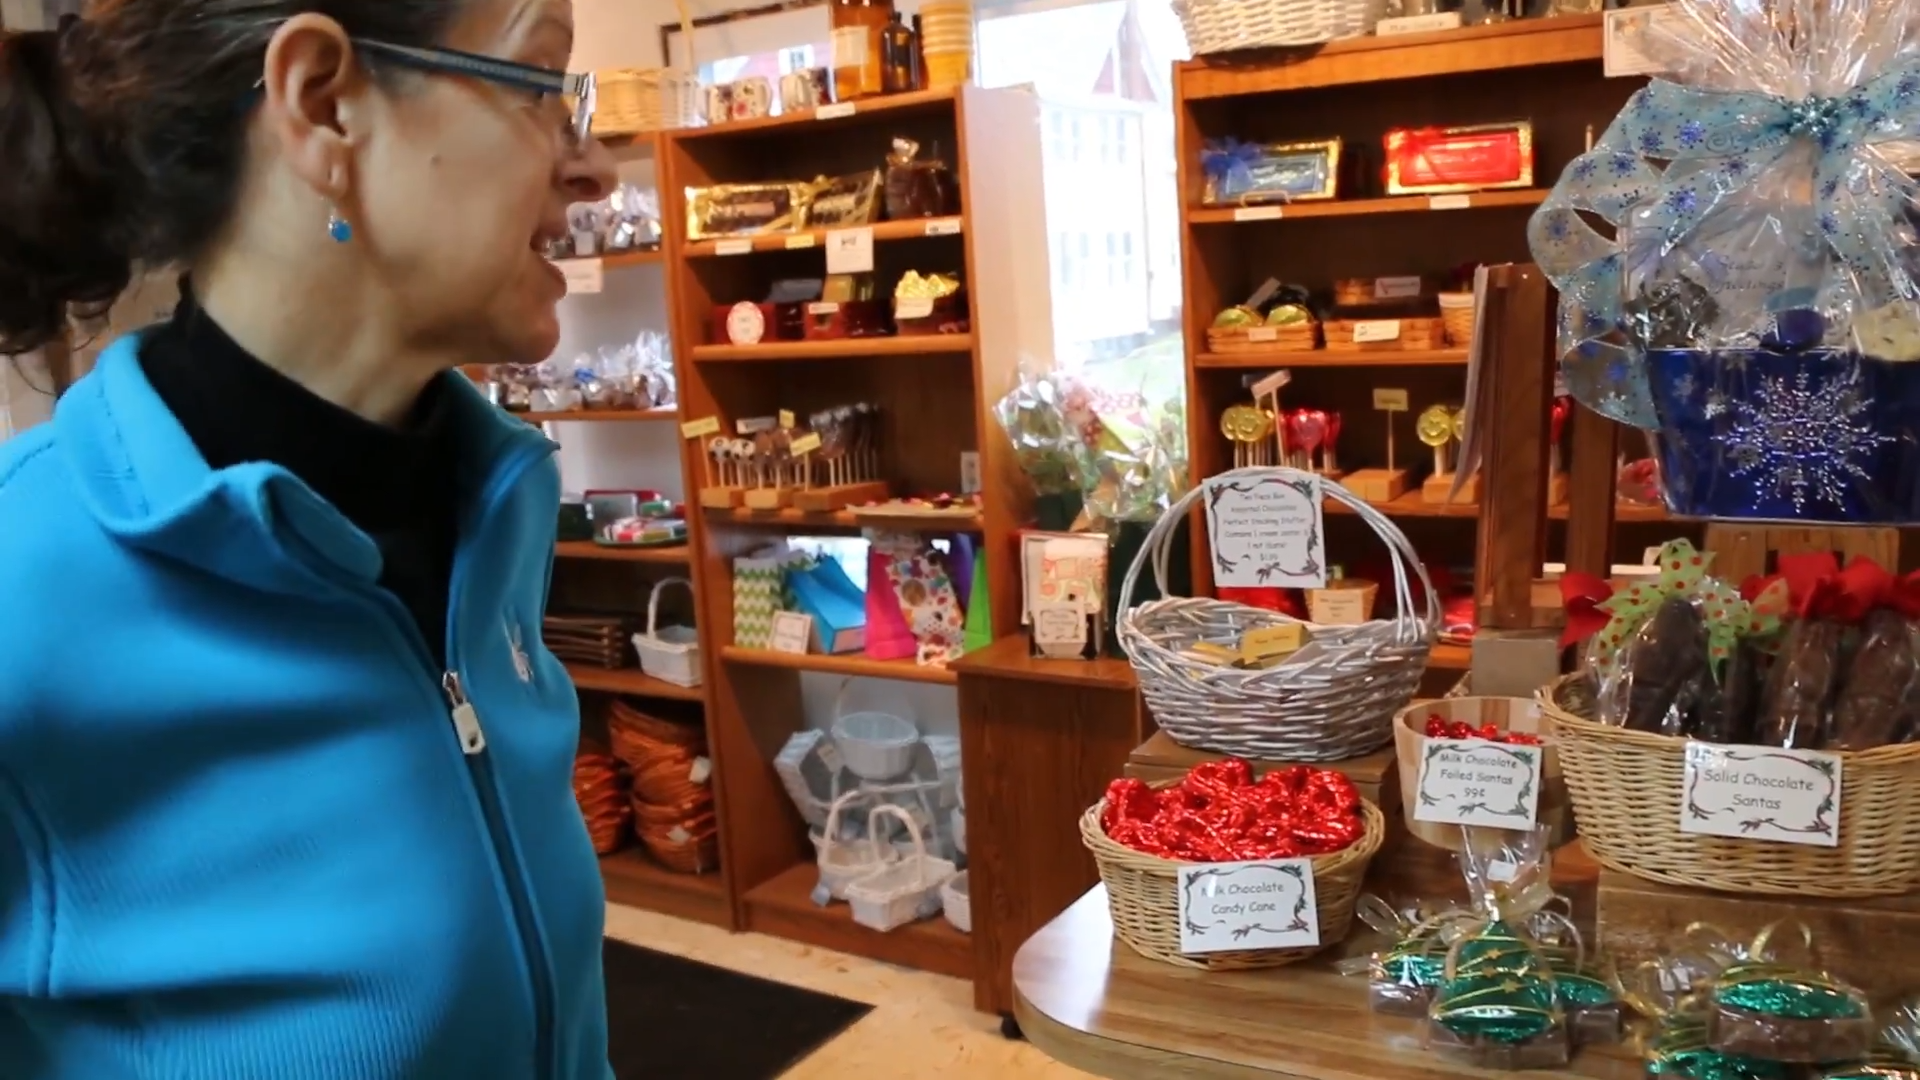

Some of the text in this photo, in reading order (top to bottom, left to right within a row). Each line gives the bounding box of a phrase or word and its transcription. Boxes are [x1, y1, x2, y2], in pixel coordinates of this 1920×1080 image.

[1441, 753, 1517, 769] Milk Chocolate
[1441, 769, 1513, 785] Foiled Santas
[1703, 769, 1814, 791] Solid Chocolate
[1464, 787, 1485, 797] 99¢
[1732, 794, 1782, 810] Santas
[1228, 882, 1284, 895] Chocolate
[1211, 901, 1276, 915] Candy Cane
